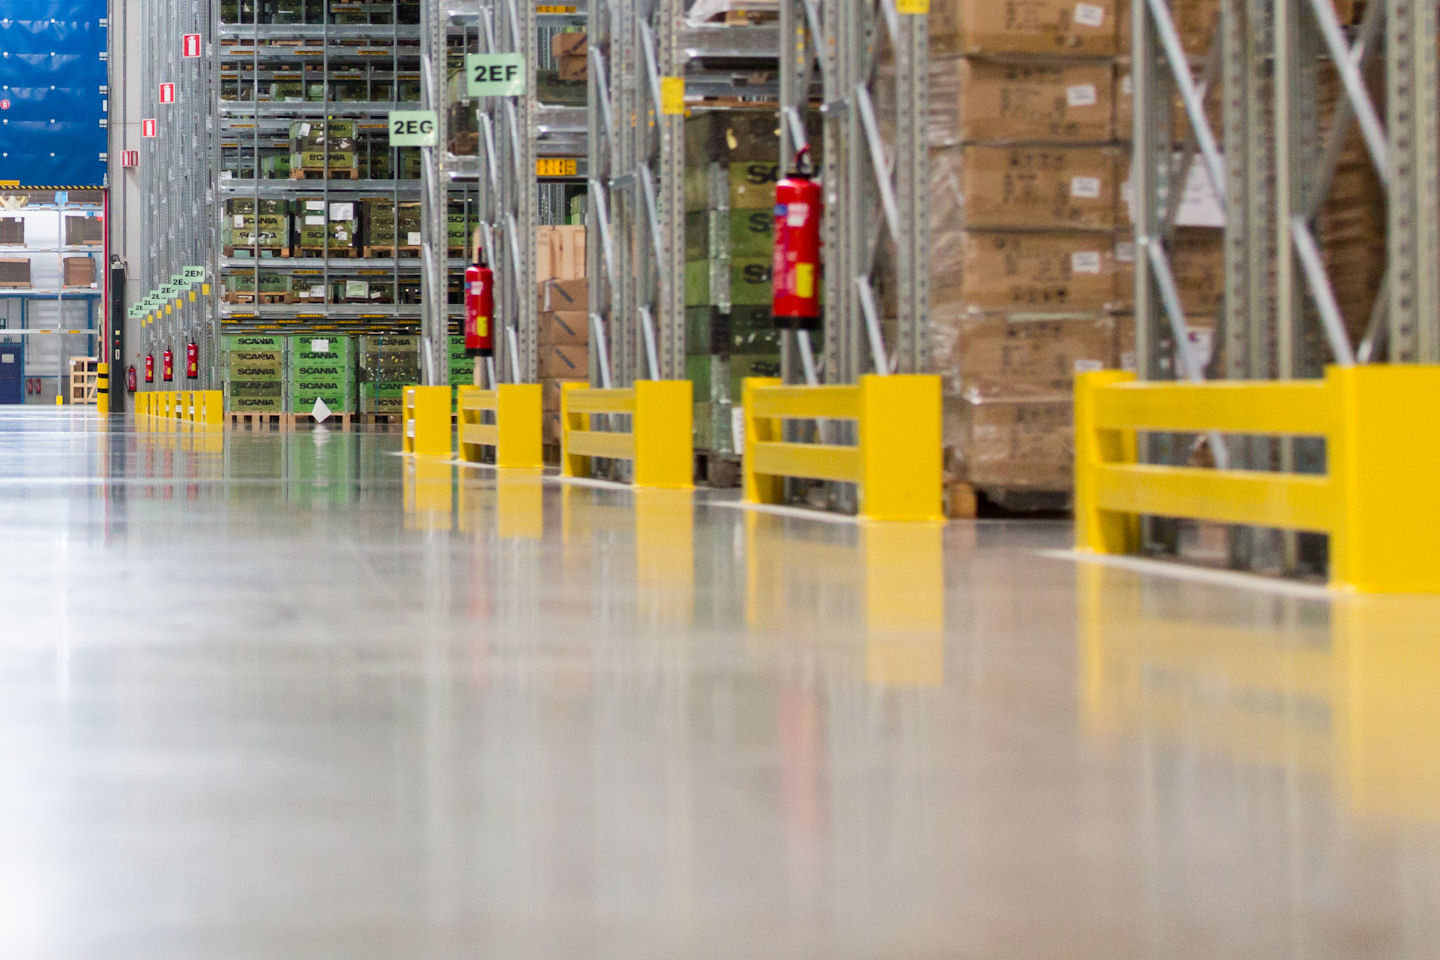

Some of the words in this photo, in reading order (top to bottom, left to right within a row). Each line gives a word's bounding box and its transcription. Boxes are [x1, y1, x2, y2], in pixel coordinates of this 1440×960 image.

[474, 65, 518, 82] 2EF
[394, 120, 433, 134] 2EG
[237, 353, 276, 361] SCANIA
[300, 352, 338, 360] SCANIA
[299, 382, 338, 390] SCANIA
